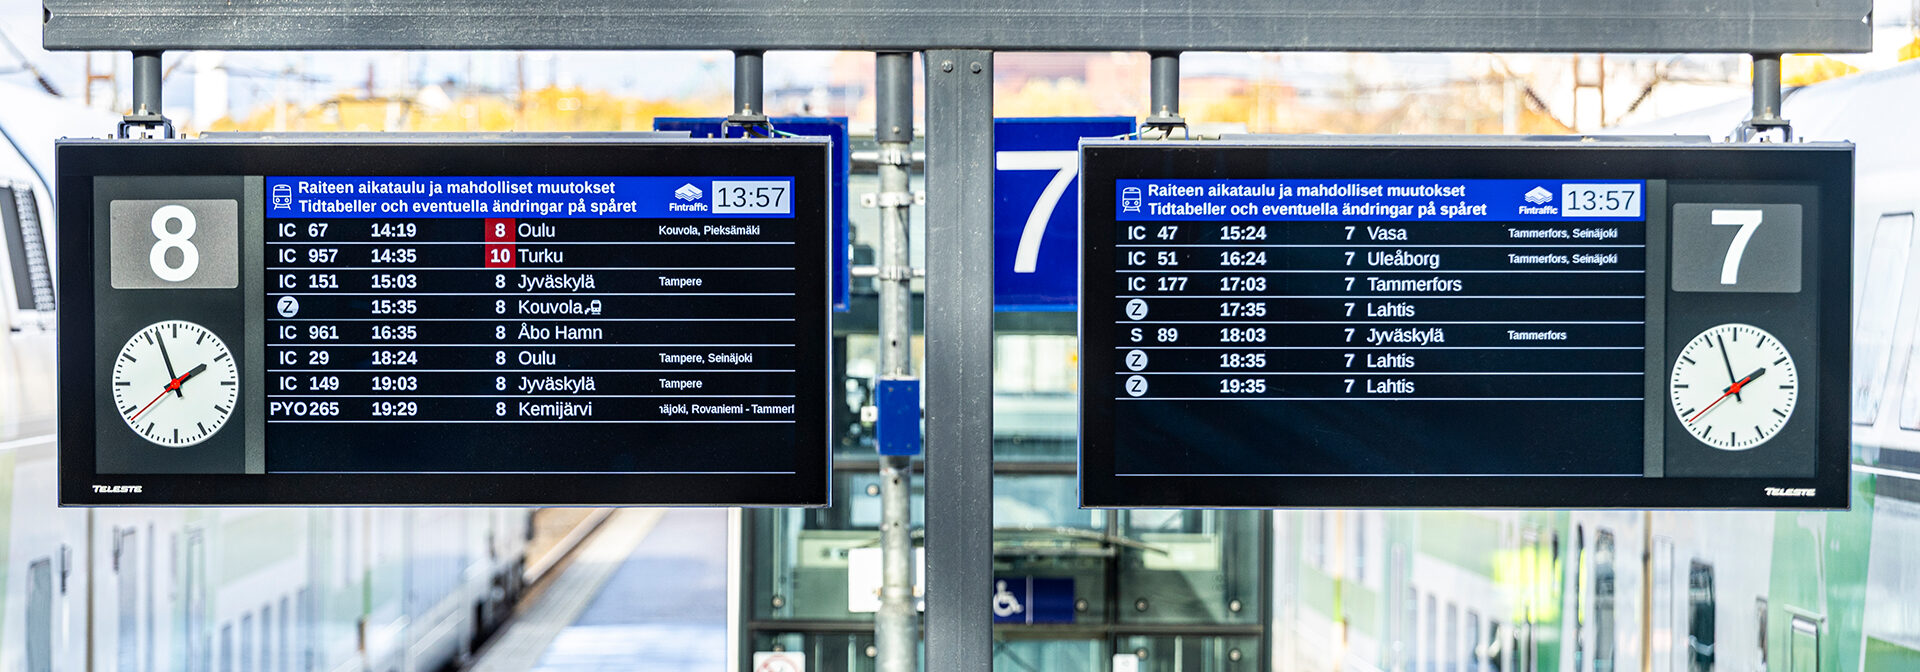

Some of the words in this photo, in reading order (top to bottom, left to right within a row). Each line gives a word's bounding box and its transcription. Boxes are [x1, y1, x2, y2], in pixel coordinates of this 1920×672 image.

[299, 181, 353, 193] Raiteen
[359, 181, 424, 193] aikataulu
[429, 181, 442, 196] ja
[448, 181, 532, 193] mahdolliset
[538, 181, 615, 194] muutokset
[1149, 184, 1203, 196] Raiteen
[1208, 184, 1274, 196] aikataulu
[1279, 184, 1292, 199] ja
[1297, 184, 1383, 196] mahdolliset
[1388, 184, 1465, 196] muutokset
[718, 187, 785, 208] 13:57
[1568, 190, 1635, 211] 13:57
[299, 200, 376, 212] Tidtabeller
[381, 200, 408, 212] och
[413, 200, 488, 212] eventuella
[493, 200, 563, 215] ändringar
[569, 199, 586, 215] på
[591, 199, 636, 215] spåret
[669, 203, 708, 211] Fintraffic
[997, 151, 1077, 272] 7
[1148, 202, 1226, 215] Tidtabeller
[1231, 203, 1258, 215] och
[1262, 203, 1338, 215] eventuella
[1342, 203, 1414, 218] ändringar
[1418, 202, 1436, 218] på
[1440, 202, 1487, 218] spåret
[1519, 205, 1558, 214] Fintraffic
[279, 223, 297, 237] IC
[308, 223, 328, 237] 67
[371, 223, 416, 237] 14:19
[495, 223, 505, 237] 8
[518, 223, 556, 237] Oulu
[659, 225, 700, 236] Kouvola,
[704, 224, 760, 235] Pieksämäki
[1128, 226, 1146, 240] IC
[1157, 226, 1178, 240] 47
[1221, 226, 1266, 240] 15:24
[1345, 226, 1355, 240] 7
[1367, 226, 1407, 240] Vasa
[1508, 228, 1569, 239] Tammerfors,
[1572, 227, 1618, 240] Seinäjoki
[150, 206, 198, 281] 8
[1712, 210, 1762, 284] 7
[279, 249, 297, 263] IC
[308, 249, 338, 263] 957
[371, 249, 416, 263] 14:35
[490, 249, 510, 263] 10
[518, 248, 563, 263] Turku
[1128, 251, 1146, 265] IC
[1157, 252, 1178, 265] 51
[1221, 251, 1266, 265] 16:24
[1345, 252, 1355, 265] 7
[1367, 250, 1440, 268] Uleåborg
[1508, 253, 1569, 265] Tammerfors,
[1572, 253, 1618, 265] Seinäjoki
[279, 274, 297, 288] IC
[309, 274, 338, 288] 151
[371, 274, 416, 288] 15:03
[495, 274, 505, 288] 8
[518, 274, 595, 292] Jyväskylä
[659, 276, 702, 288] Tampere
[1128, 277, 1146, 291] IC
[1158, 277, 1188, 291] 177
[1221, 277, 1266, 291] 17:03
[1345, 277, 1355, 291] 7
[1367, 277, 1462, 291] Tammerfors
[371, 300, 417, 314] 15:35
[495, 300, 505, 314] 8
[518, 300, 583, 314] Kouvola
[1221, 303, 1266, 316] 17:35
[1345, 303, 1355, 316] 7
[1367, 302, 1415, 317] Lahtis
[279, 326, 297, 339] IC
[309, 326, 339, 339] 961
[371, 325, 417, 339] 16:35
[495, 326, 506, 339] 8
[518, 323, 550, 339] Åbo
[555, 326, 602, 339] Hamn
[1131, 328, 1142, 342] S
[1157, 328, 1178, 342] 89
[1220, 328, 1266, 342] 18:03
[1345, 328, 1355, 342] 7
[1367, 328, 1444, 345] Jyväskylä
[1508, 330, 1567, 340] Tammerfors
[280, 351, 297, 365] IC
[309, 351, 329, 365] 29
[372, 351, 417, 365] 18:24
[496, 351, 506, 365] 8
[518, 351, 556, 365] Oulu
[659, 353, 705, 364] Tampere,
[708, 353, 752, 365] Seinäjoki
[1220, 354, 1266, 368] 18:35
[1344, 354, 1354, 367] 7
[1367, 353, 1414, 368] Lahtis
[280, 377, 297, 390] IC
[309, 376, 339, 390] 149
[372, 376, 417, 390] 19:03
[496, 377, 506, 390] 8
[518, 376, 595, 394] Jyväskylä
[659, 378, 702, 390] Tampere
[1220, 379, 1266, 393] 19:35
[1344, 379, 1354, 393] 7
[1367, 379, 1414, 393] Lahtis
[309, 402, 339, 416] 265
[372, 402, 417, 416] 19:29
[496, 402, 506, 416] 8
[518, 402, 592, 419] Kemijärvi
[692, 404, 743, 414] Rovaniemi
[92, 484, 142, 493] TELESTE
